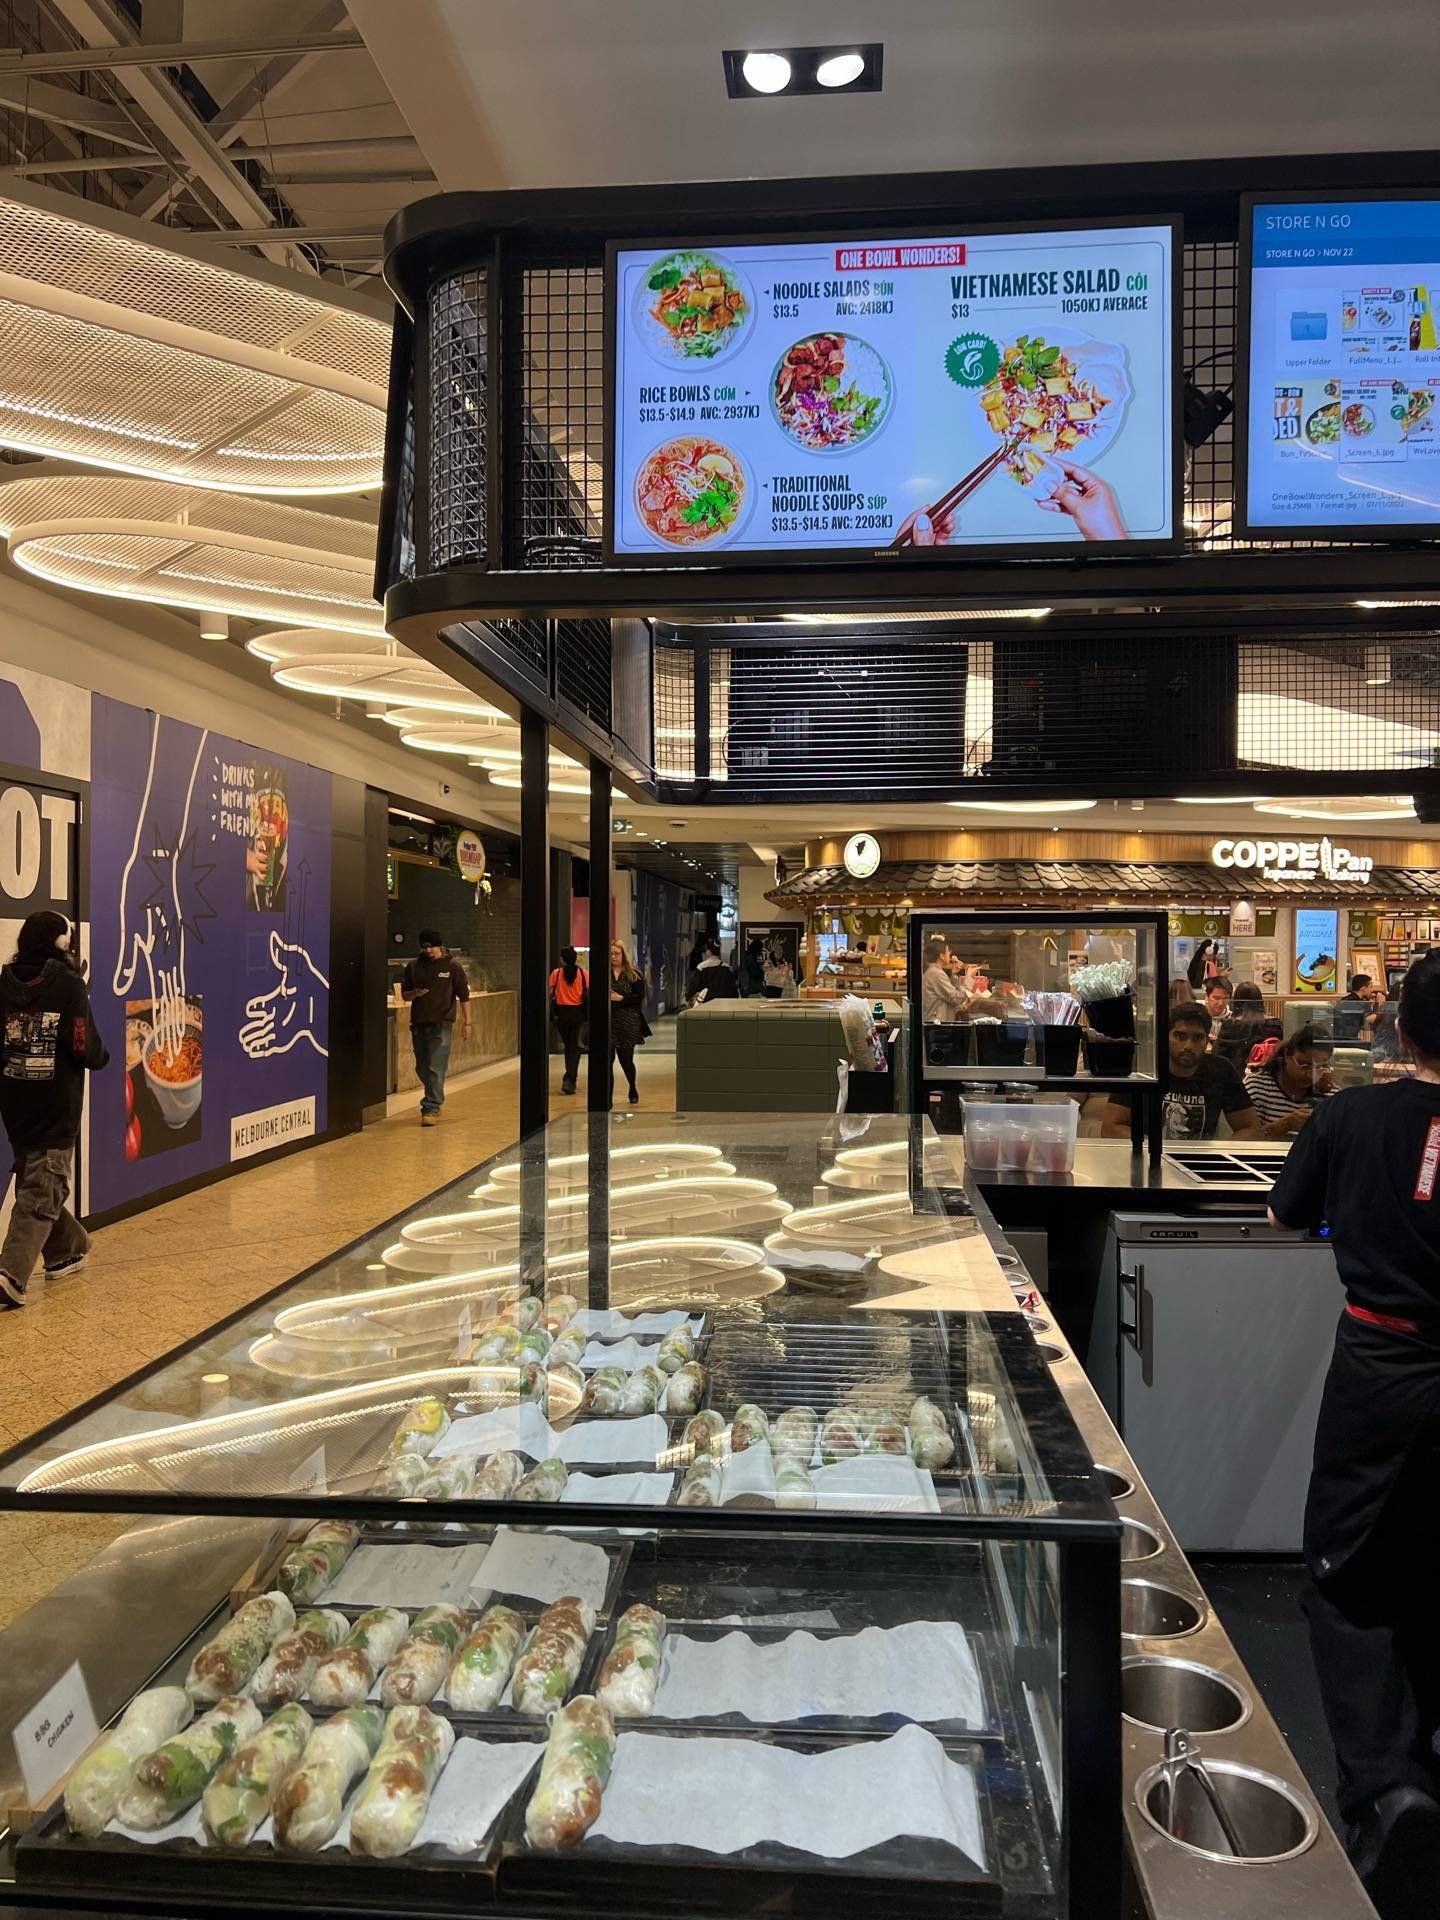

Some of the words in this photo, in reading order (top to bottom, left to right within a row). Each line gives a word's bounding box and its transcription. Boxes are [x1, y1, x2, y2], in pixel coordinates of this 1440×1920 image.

[1265, 216, 1311, 230] STORE
[1315, 215, 1326, 228] N
[1330, 214, 1351, 228] GO
[840, 251, 864, 269] ONE
[866, 249, 898, 267] BOWL
[900, 246, 961, 266] WONDERS!
[1265, 249, 1293, 259] STORE
[1294, 249, 1301, 258] N
[1302, 249, 1316, 258] GO
[1323, 248, 1342, 257] NOV
[1342, 247, 1354, 257] 22
[773, 282, 820, 300] NOODLE
[823, 279, 870, 298] SALADS
[950, 272, 1058, 300] VIETNAMESE
[1063, 268, 1120, 295] SALAD
[773, 304, 799, 319] $13.5
[860, 300, 894, 315] 2418KJ
[951, 303, 970, 319] $13
[1062, 298, 1100, 314] 1050KJ
[639, 387, 667, 404] RICE
[669, 385, 711, 402] BOWLS
[639, 407, 695, 423] $13.5-$14.9
[700, 406, 722, 420] AVG:
[724, 405, 760, 420] 2937KJ
[772, 475, 851, 494] TRADITIONAL
[772, 495, 820, 512] NOODLE
[822, 494, 865, 511] SOUPS
[771, 516, 829, 532] $13.5-$14.5
[831, 515, 853, 530] AVG:
[855, 514, 893, 529] 2203KJ
[222, 763, 255, 788] DRINKS
[221, 788, 242, 809] WITH
[220, 810, 261, 839] FRIENDS
[1211, 839, 1320, 869] COPPE
[1332, 848, 1373, 872] Pan
[1328, 868, 1370, 885] Bakery
[235, 1117, 278, 1149] MELBOURNE
[281, 1108, 312, 1134] CENTRAL
[47, 1711, 75, 1748] CHICKEN
